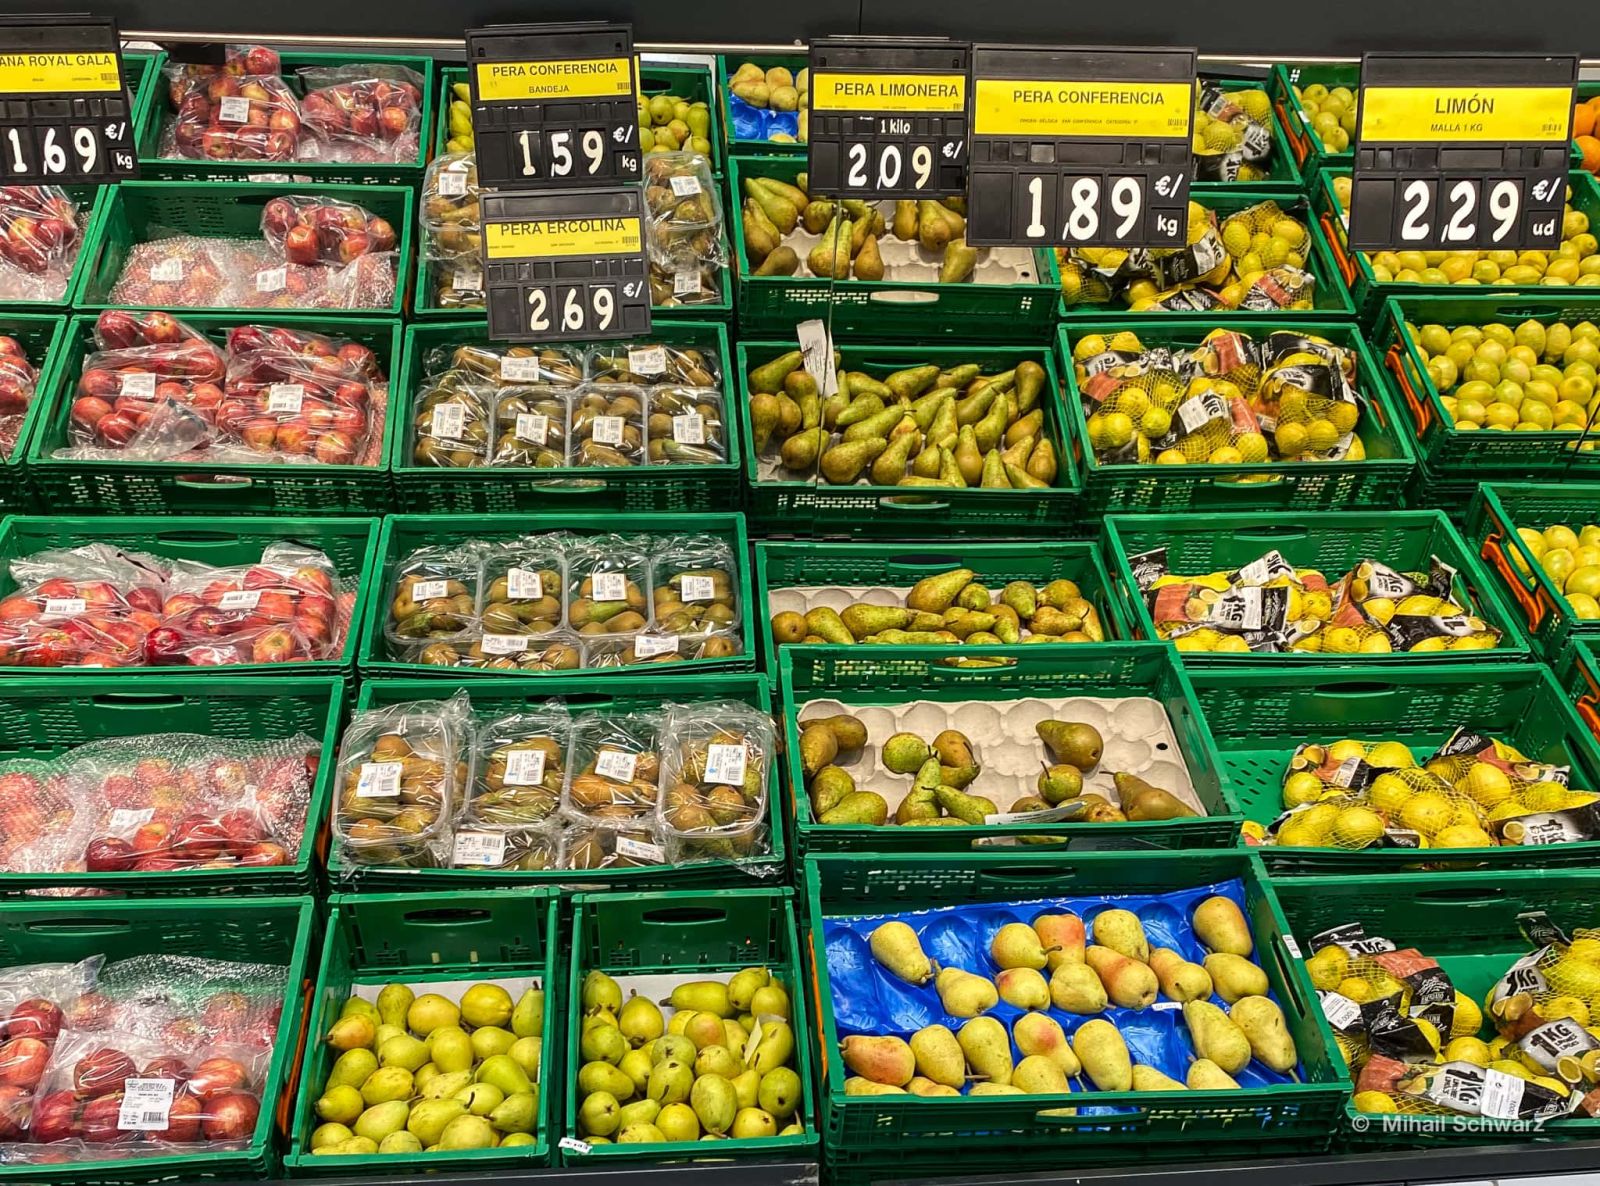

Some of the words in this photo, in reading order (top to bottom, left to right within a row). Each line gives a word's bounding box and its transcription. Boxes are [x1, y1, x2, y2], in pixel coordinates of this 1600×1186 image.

[0, 55, 25, 66] ANA
[29, 55, 73, 66] ROYAL
[76, 54, 112, 66] GALA
[493, 64, 525, 77] PERA
[529, 62, 618, 76] CONFERENCIA
[528, 85, 569, 94] BANDEJA
[834, 82, 875, 97] PERA
[880, 83, 959, 97] LIMONERA
[1013, 90, 1053, 103] PERA
[1058, 90, 1165, 105] CONFERENCIA
[1435, 93, 1494, 114] LIMÓN
[880, 119, 886, 134] 1
[890, 119, 911, 134] kilo
[1430, 123, 1461, 132] MALLA
[1464, 123, 1468, 132] 1
[1470, 123, 1483, 132] KG
[116, 151, 133, 169] kg
[622, 155, 637, 172] kg
[501, 221, 542, 236] PERA
[547, 218, 626, 234] ERCOLINA
[1157, 214, 1178, 237] kg
[1532, 219, 1555, 236] ud
